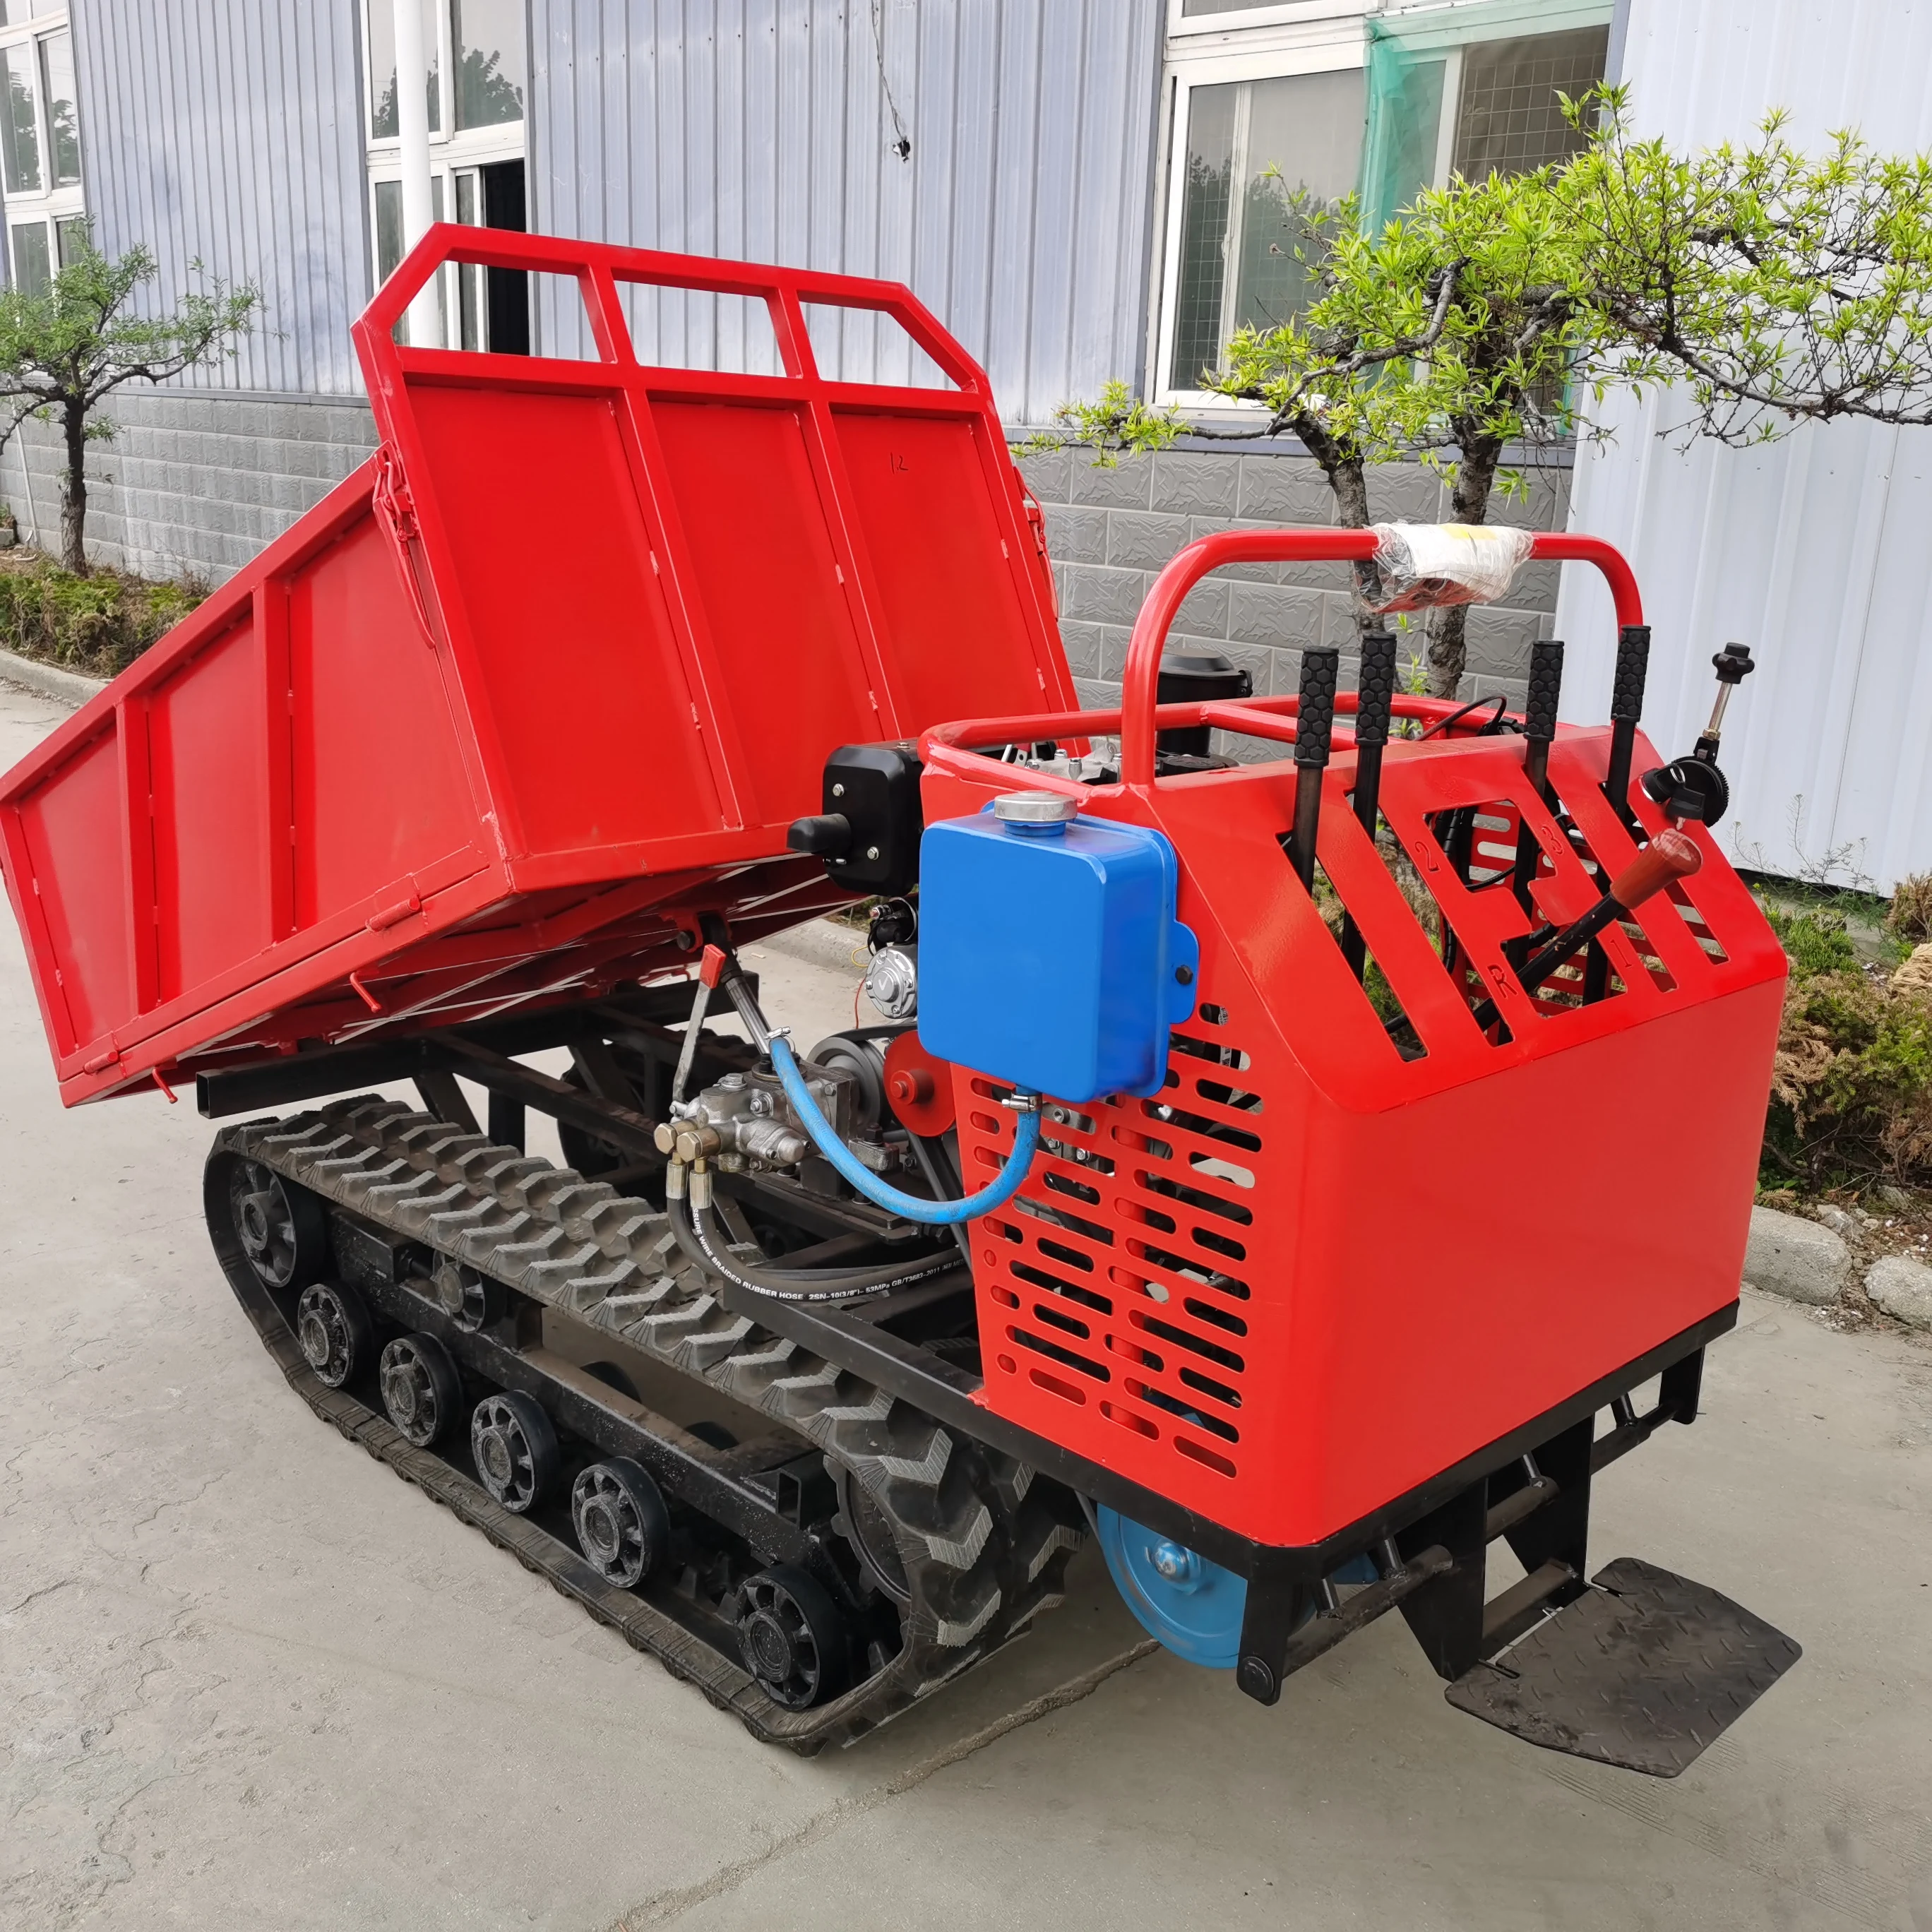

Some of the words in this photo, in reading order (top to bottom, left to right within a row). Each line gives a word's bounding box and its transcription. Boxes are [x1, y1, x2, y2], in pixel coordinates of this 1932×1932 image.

[1414, 840, 1441, 872] 2
[1541, 825, 1565, 855] 3
[1609, 939, 1633, 968] 1
[1486, 964, 1518, 999] R
[699, 1236, 714, 1257] WIRE
[711, 1256, 741, 1284] BRAIDED
[742, 1281, 777, 1298] RUBBER
[779, 1292, 804, 1301] HOSE
[866, 1283, 890, 1293] 53MPa
